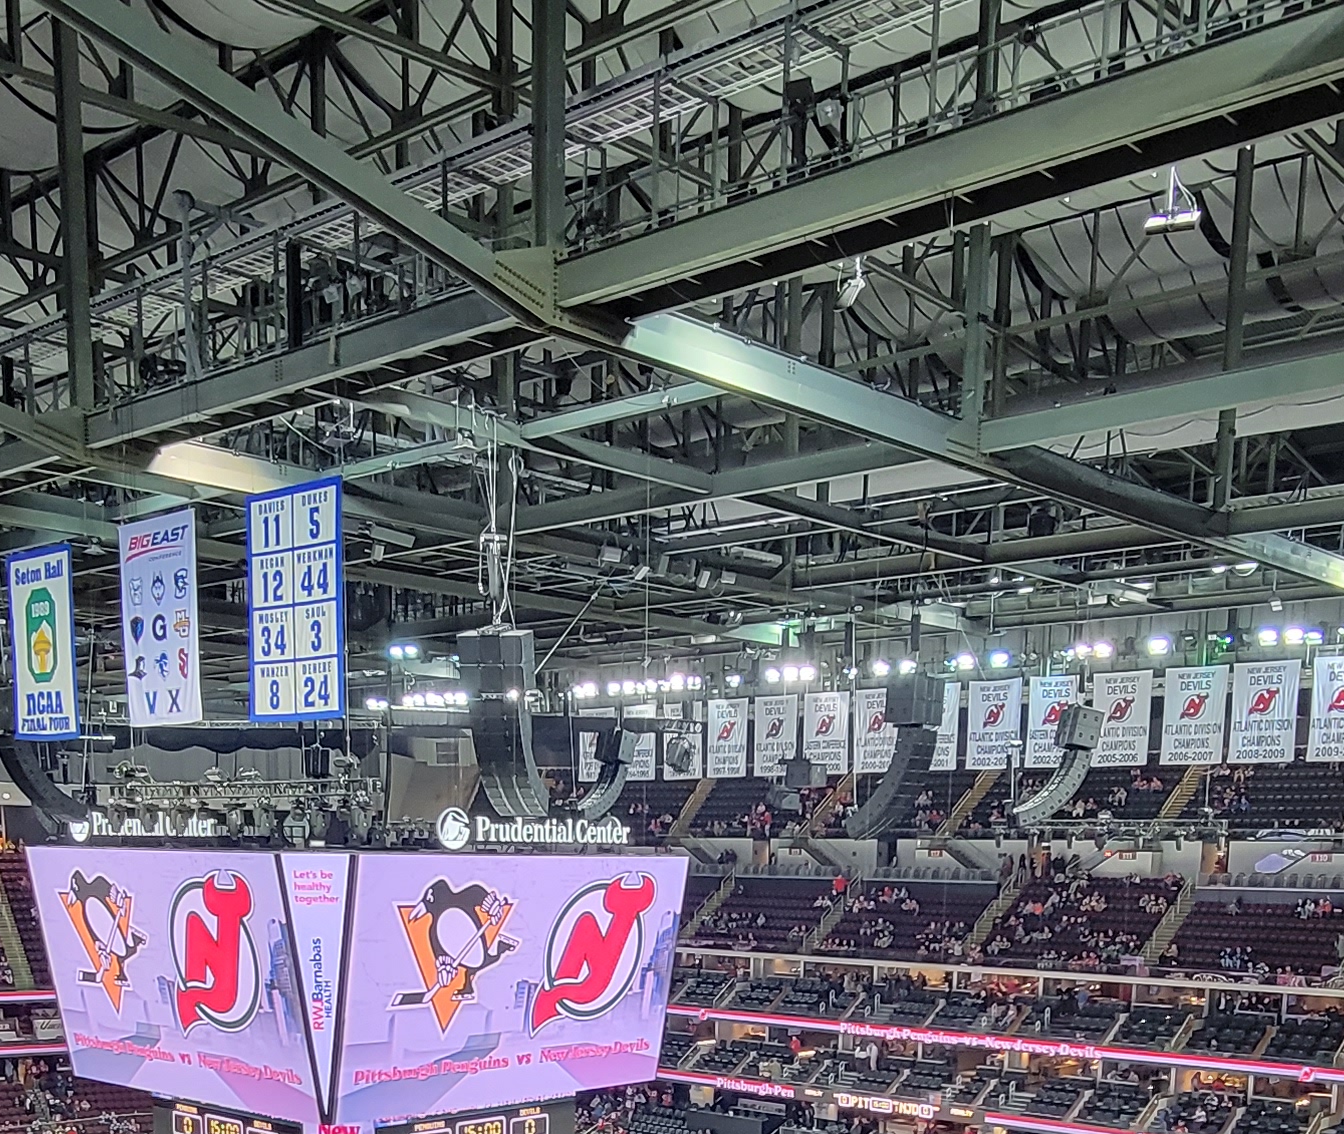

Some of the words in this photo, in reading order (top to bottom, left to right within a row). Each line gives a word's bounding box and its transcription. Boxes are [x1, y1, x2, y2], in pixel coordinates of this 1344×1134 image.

[302, 491, 328, 506] DUKES
[258, 500, 285, 515] DAVIES
[309, 507, 320, 539] 5
[128, 534, 151, 551] BIG
[151, 525, 188, 545] EAST
[263, 515, 280, 548] 11
[260, 556, 285, 569] REGAN
[297, 548, 334, 563] WERKMAN
[15, 568, 42, 586] Seton
[44, 559, 63, 579] Hall
[301, 562, 329, 596] 44
[262, 570, 283, 602] 12
[259, 611, 288, 624] MOSLEY
[306, 606, 326, 619] SAUL
[261, 625, 286, 656] 34
[311, 620, 321, 651] 3
[303, 661, 331, 675] DEHERE
[1180, 681, 1211, 690] DEVILS
[1250, 675, 1282, 685] DEVILS
[270, 680, 279, 709] 8
[304, 675, 330, 707] 24
[982, 692, 1008, 702] DEVILS
[1042, 689, 1070, 698] DEVILS
[1107, 685, 1136, 695] DEVILS
[1165, 725, 1192, 734] ATLANTIC
[1194, 723, 1221, 734] DIVISION
[1312, 718, 1344, 729] ATLANTIC
[1122, 725, 1147, 737] DIVISION
[1102, 740, 1136, 751] CHAMPIONS
[1174, 739, 1209, 749] CHAMPIONS
[1242, 736, 1280, 747] CHAMPIONS
[1098, 754, 1138, 763] 2005-2006
[1168, 752, 1213, 761] 2006-2007
[1236, 749, 1285, 759] 2008-2009
[476, 816, 573, 843] Prudential
[576, 816, 630, 843] Center
[293, 870, 316, 879] Let's
[320, 870, 333, 879] be
[294, 882, 331, 893] healthy
[295, 894, 339, 905] together
[310, 938, 324, 1030] RWJBarnabas
[840, 1022, 900, 1040] Pittsburgh
[903, 1028, 957, 1045] Penguins
[1059, 1044, 1103, 1059] Devils
[74, 1033, 127, 1055] Pittsburgh
[126, 1041, 174, 1062] Penguins
[178, 1053, 191, 1065] vs
[198, 1053, 222, 1070] New
[223, 1059, 261, 1080] Jersey
[264, 1066, 301, 1084] Devils
[352, 1061, 437, 1084] Pittsburgh
[440, 1056, 509, 1076] Penguins
[516, 1054, 532, 1065] vs
[539, 1049, 568, 1063] New
[570, 1044, 612, 1059] Jersey
[614, 1039, 650, 1054] Devils
[716, 1078, 770, 1096] Pittsburgh
[773, 1085, 794, 1097] Pen
[851, 1095, 870, 1109] PIT
[899, 1102, 918, 1114] NJD
[183, 1117, 192, 1134] 0
